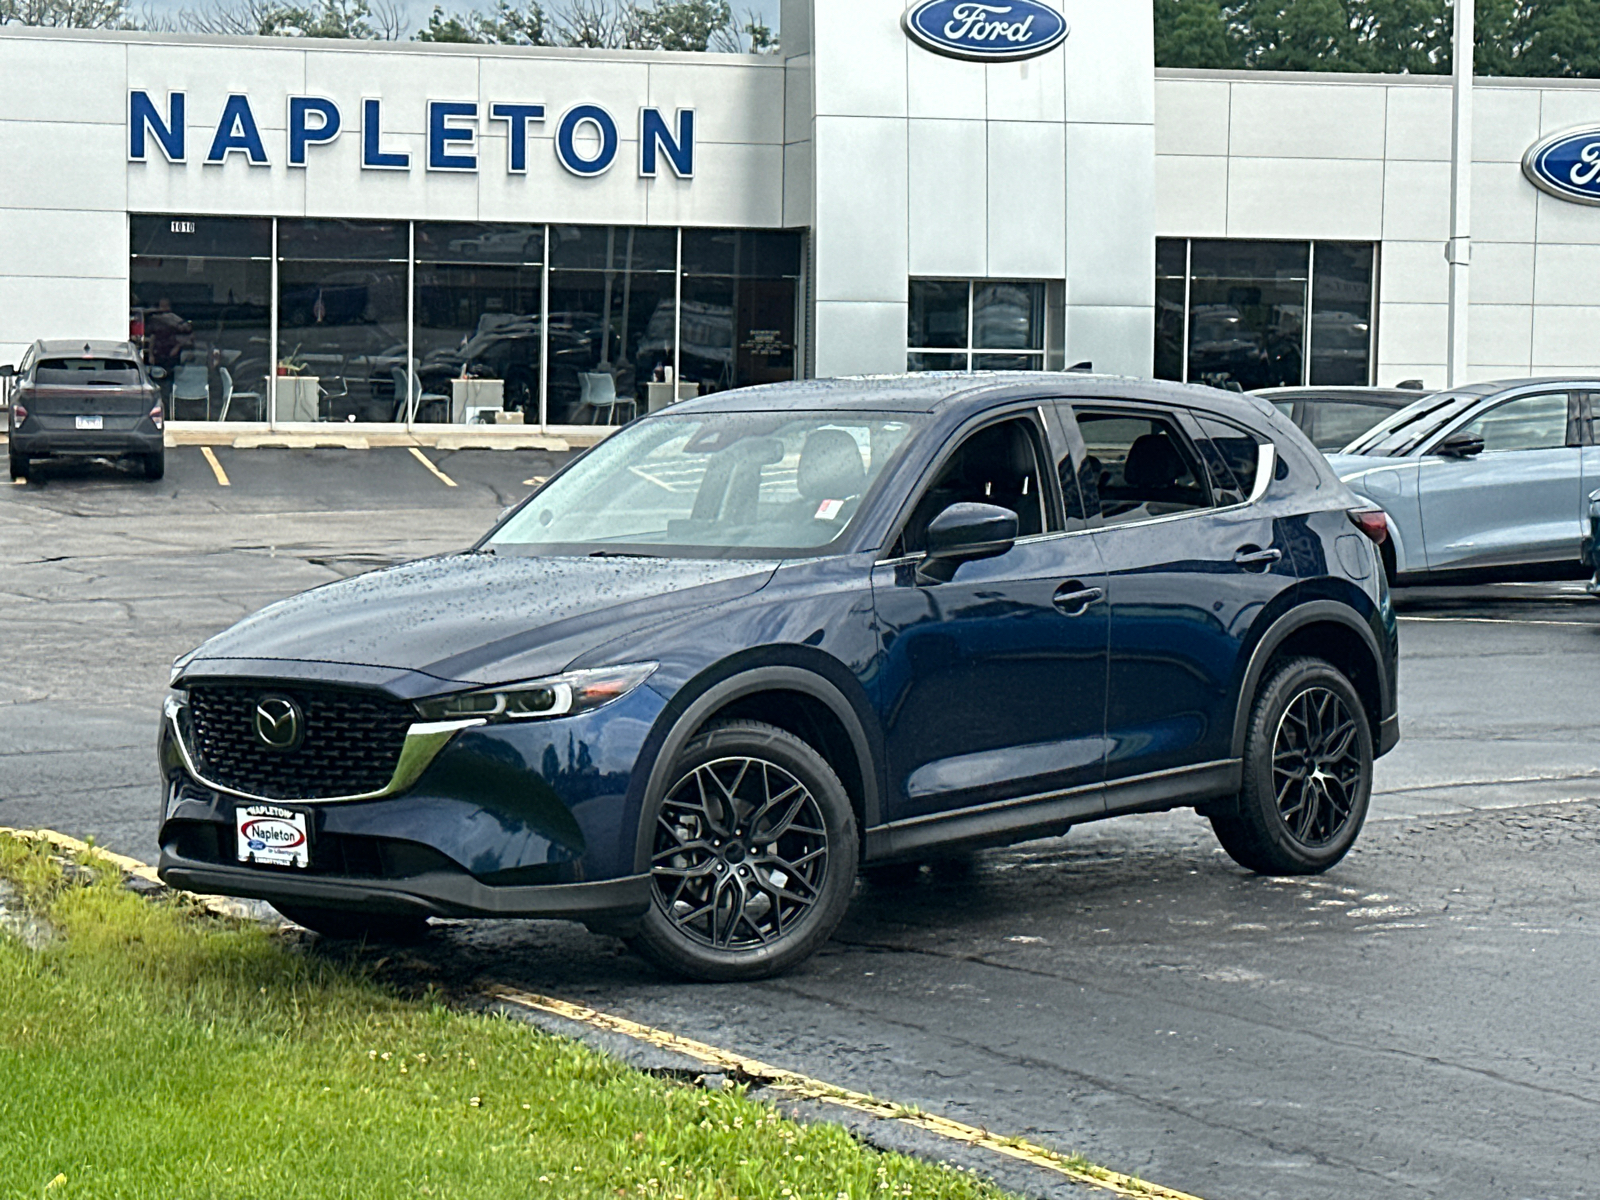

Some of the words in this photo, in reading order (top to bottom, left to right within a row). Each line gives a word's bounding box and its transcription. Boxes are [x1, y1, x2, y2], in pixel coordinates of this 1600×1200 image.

[944, 3, 1035, 42] Ford
[128, 88, 697, 178] NAPLETON
[172, 221, 195, 233] 1010
[250, 805, 292, 818] NAPLETON
[252, 825, 295, 842] Napleton
